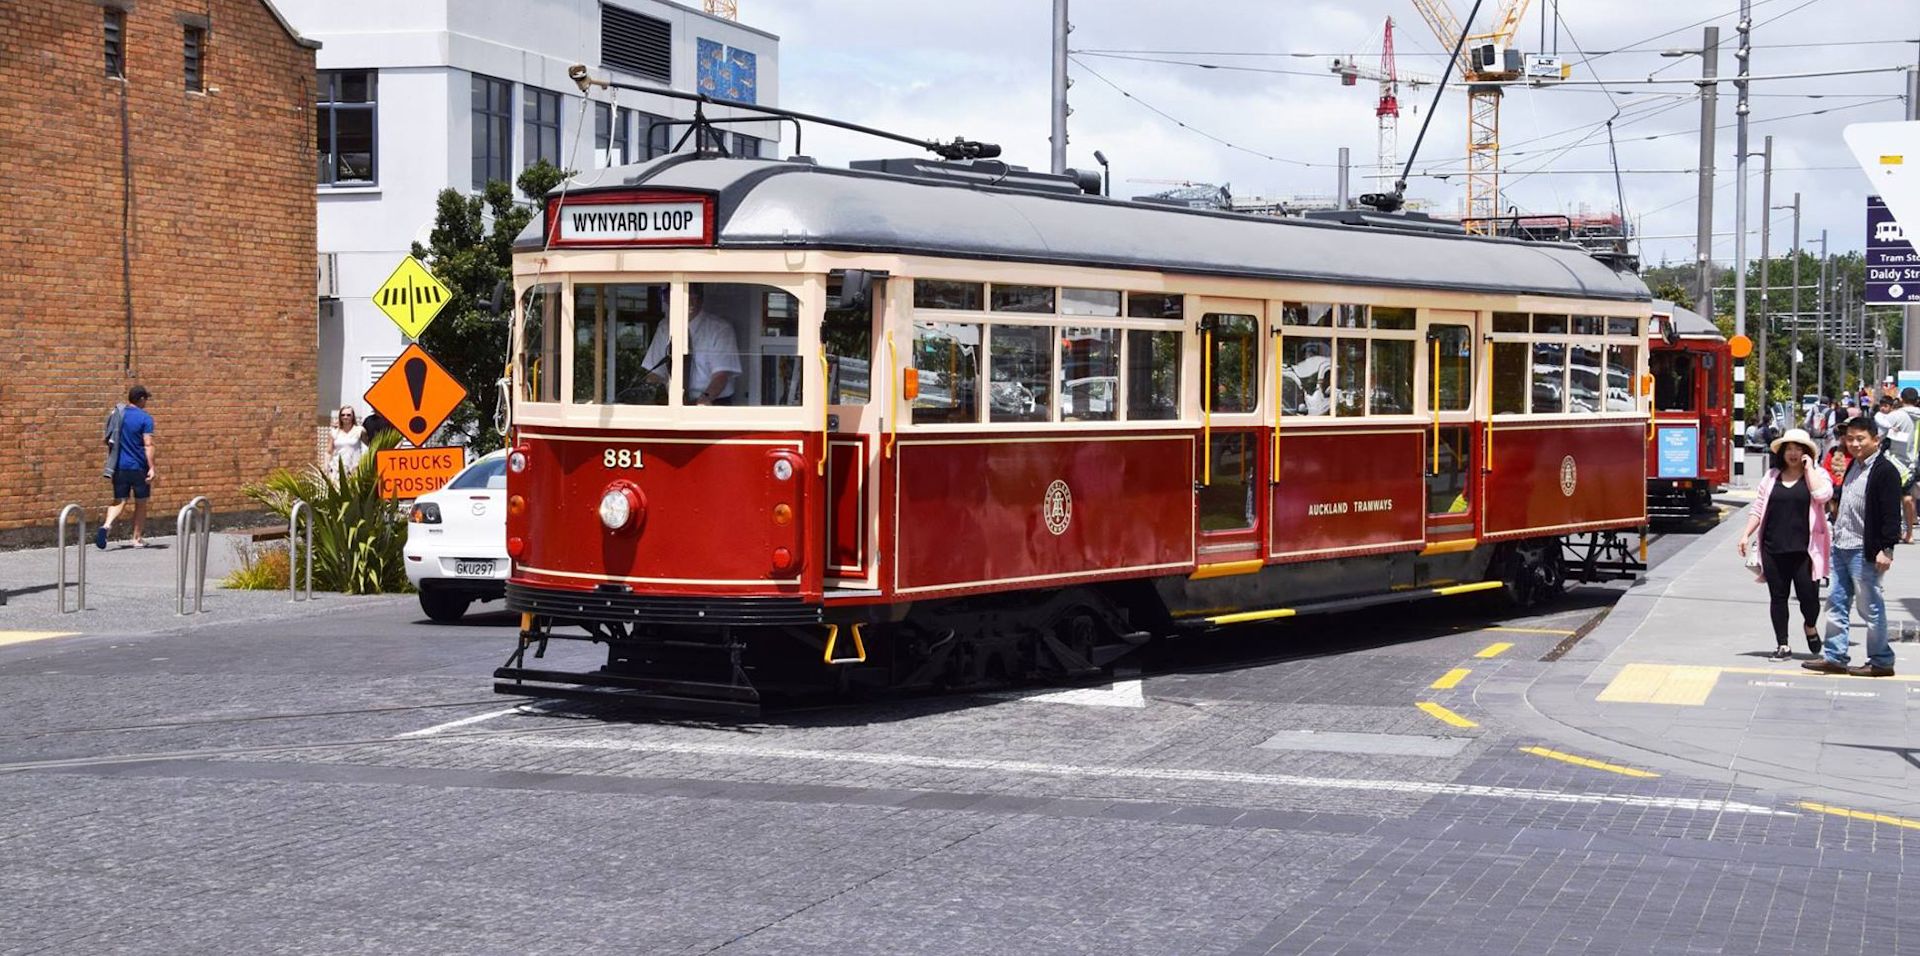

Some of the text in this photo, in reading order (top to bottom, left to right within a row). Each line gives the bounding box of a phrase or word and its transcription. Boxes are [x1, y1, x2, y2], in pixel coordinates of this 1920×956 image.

[572, 210, 694, 232] WYNYARD LOOP
[1879, 254, 1905, 262] Tram
[1870, 268, 1902, 282] Daldy
[388, 454, 453, 471] TRUCKS
[603, 448, 644, 468] 881
[383, 474, 455, 493] CROSSIN
[1308, 499, 1393, 516] AUCKLAND TRAMWAYS
[456, 561, 494, 576] GKU297
